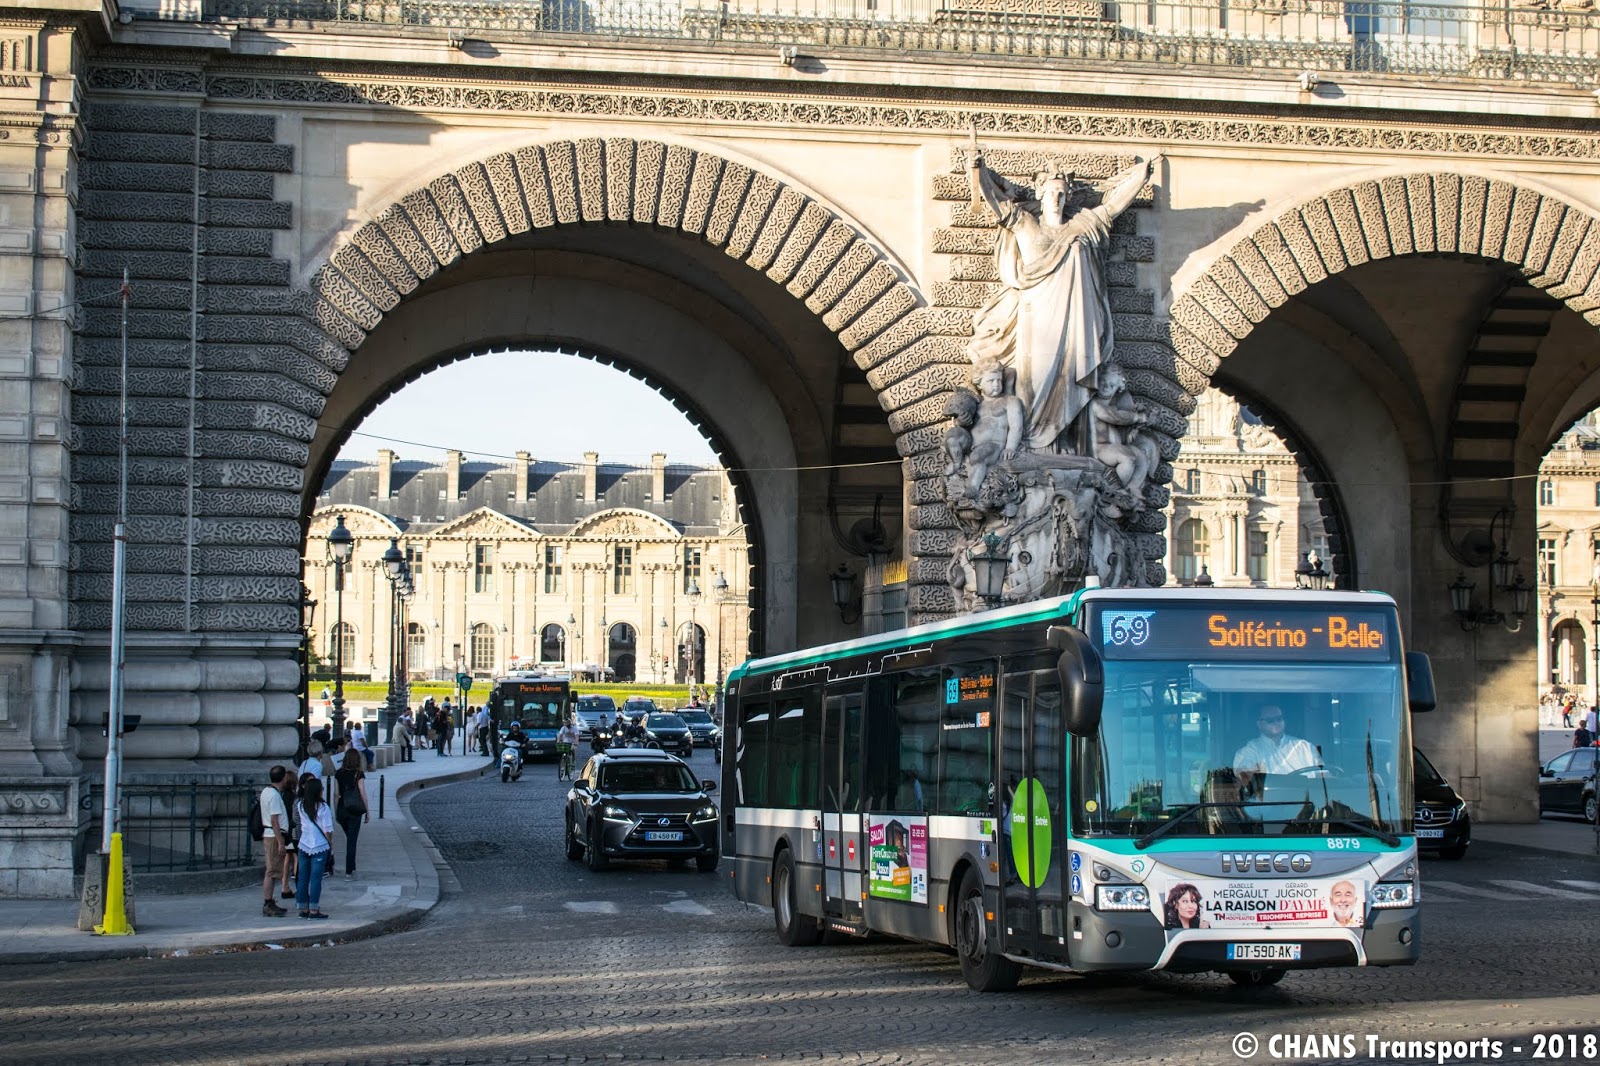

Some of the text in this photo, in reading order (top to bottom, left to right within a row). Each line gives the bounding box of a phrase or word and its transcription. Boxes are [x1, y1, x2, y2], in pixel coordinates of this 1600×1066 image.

[1109, 615, 1150, 646] 69
[1208, 615, 1307, 647] Solférino
[1328, 616, 1383, 648] Belle
[1013, 813, 1025, 823] Entrée
[1035, 816, 1048, 826] Entrée
[870, 828, 884, 842] SALON
[1326, 838, 1360, 849] 8879
[1221, 853, 1312, 873] IVECO
[1213, 889, 1269, 898] MERGAULT
[1275, 889, 1318, 898] JUGNOT
[1206, 901, 1222, 911] LA
[1225, 901, 1276, 911] RAISON
[1236, 945, 1292, 958] DT-590-AK
